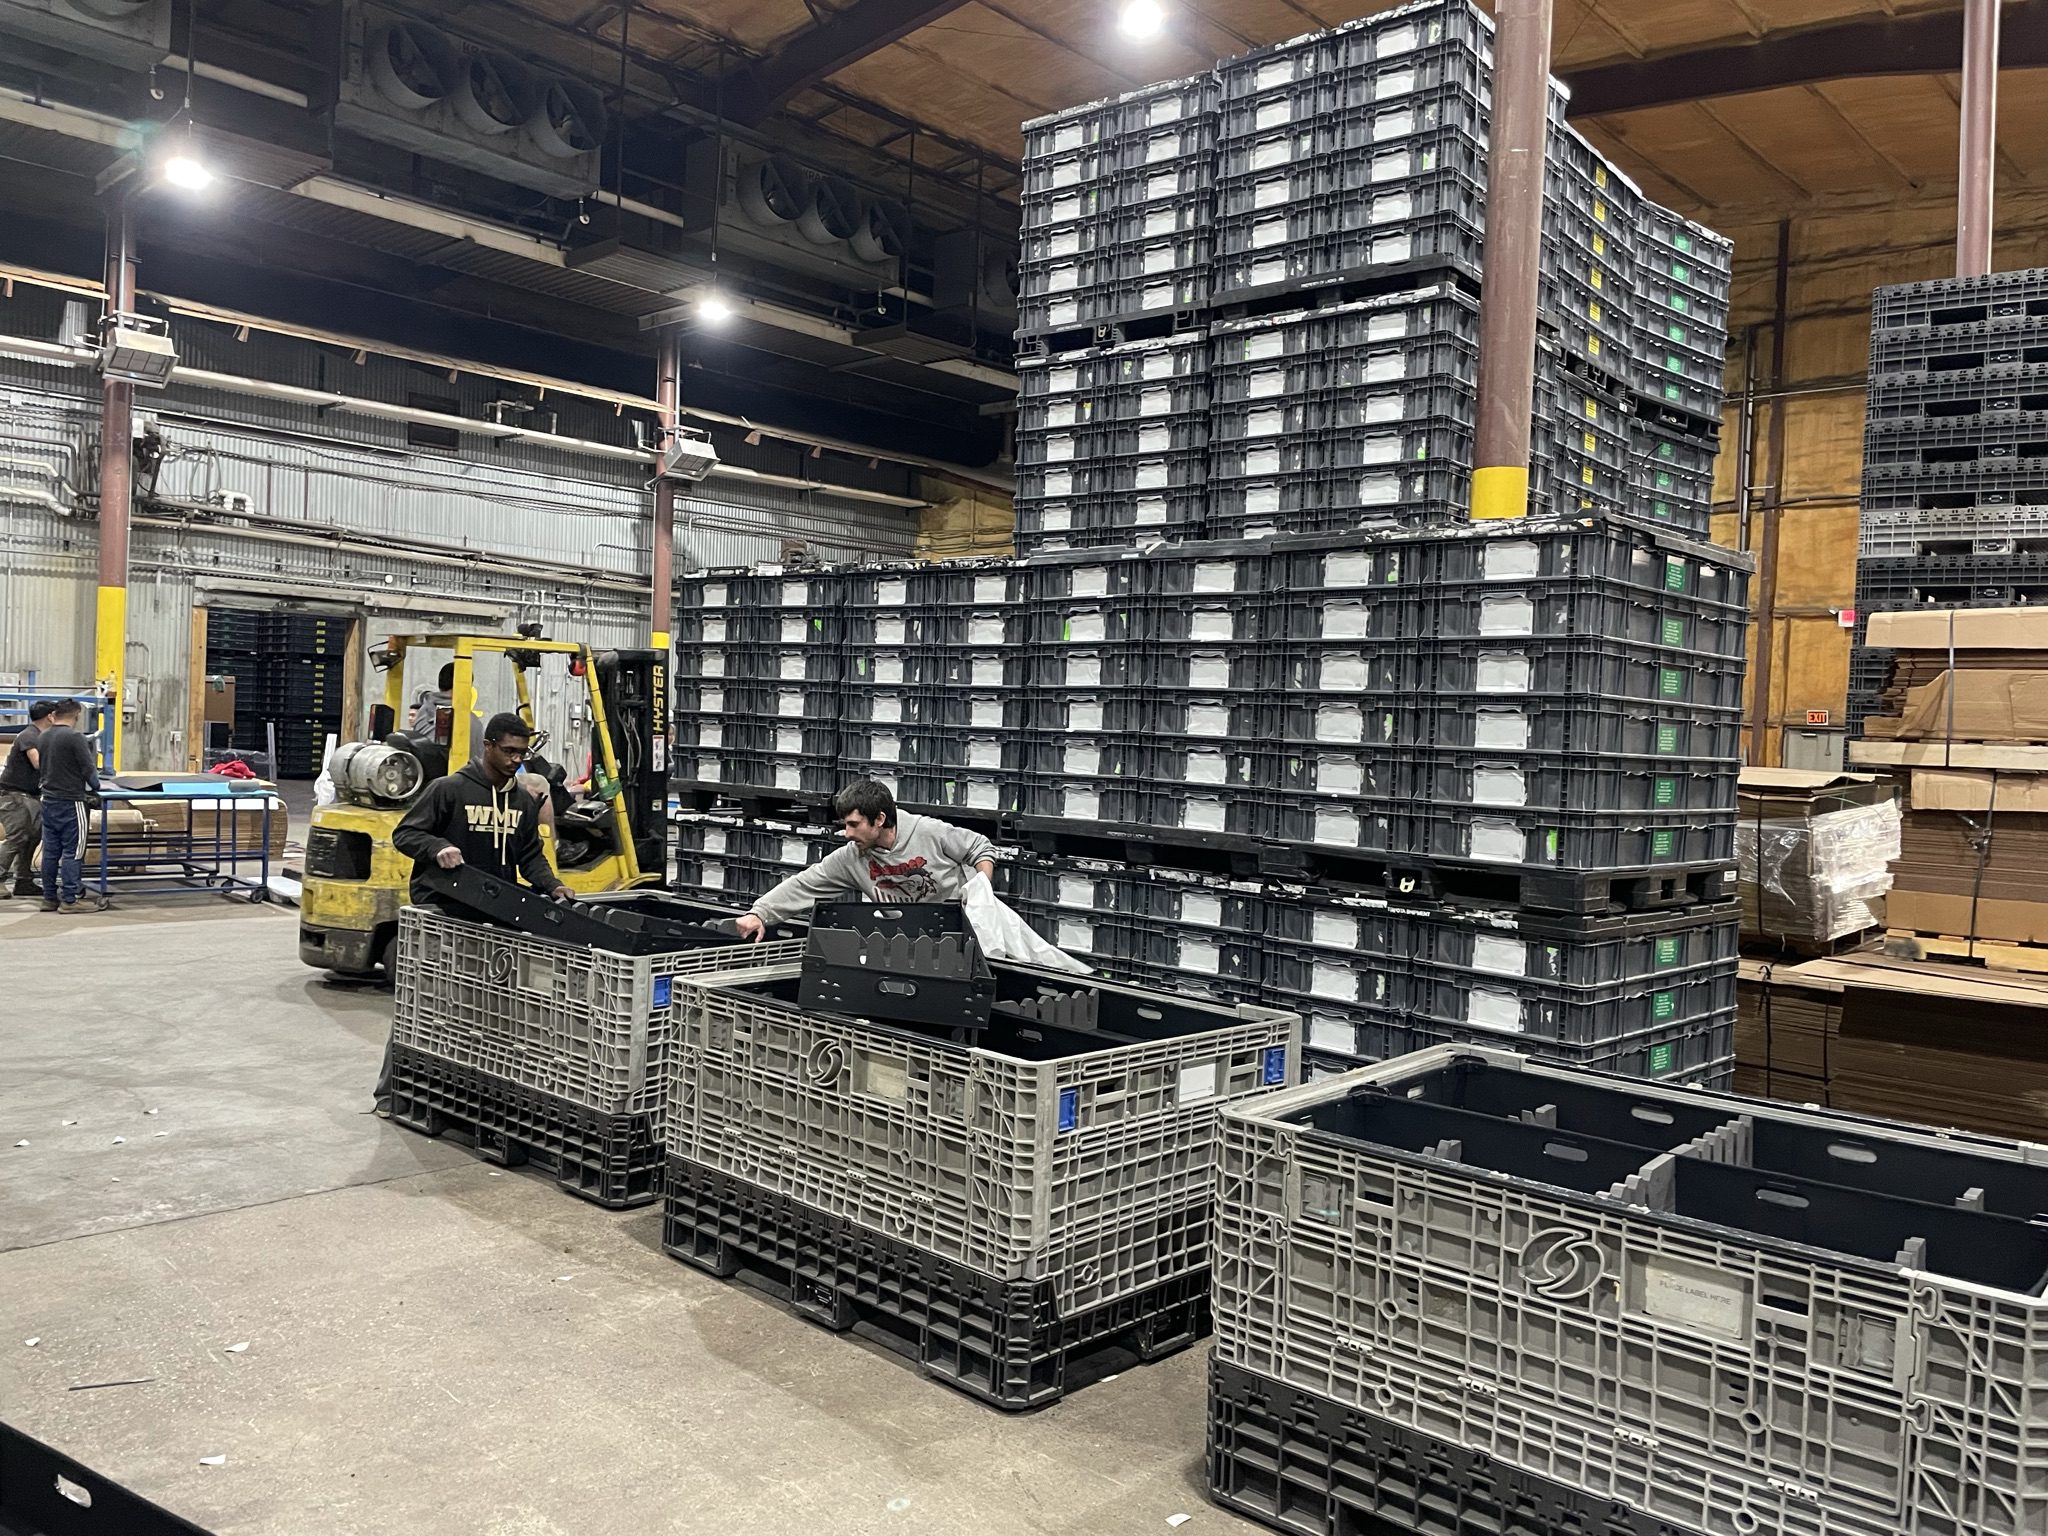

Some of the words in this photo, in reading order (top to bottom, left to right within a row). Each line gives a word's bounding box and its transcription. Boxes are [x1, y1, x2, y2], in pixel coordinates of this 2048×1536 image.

[653, 665, 664, 732] HYSTER
[1808, 712, 1827, 723] EXIT
[464, 804, 523, 828] WMU
[1685, 1287, 1708, 1299] LABEL
